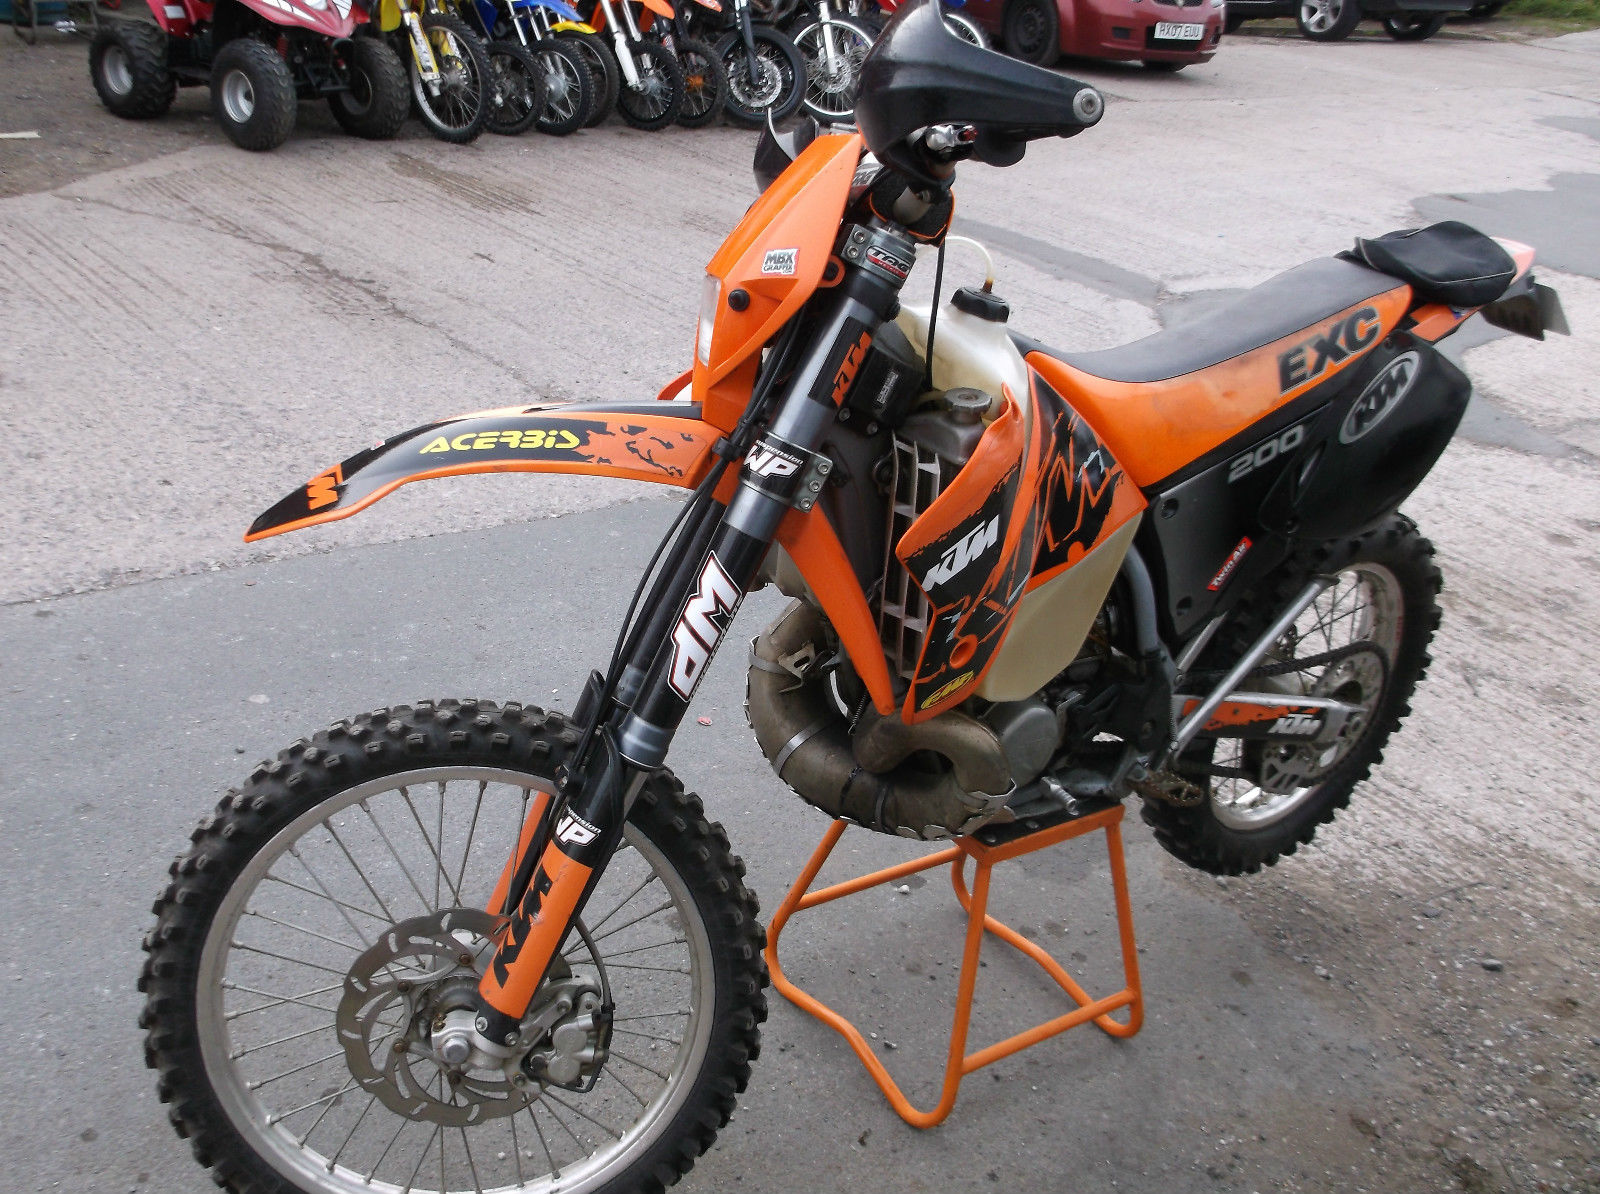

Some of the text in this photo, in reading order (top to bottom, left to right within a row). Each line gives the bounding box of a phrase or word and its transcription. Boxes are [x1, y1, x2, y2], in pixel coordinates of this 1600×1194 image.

[764, 252, 794, 264] MBX
[872, 247, 911, 273] TAG
[831, 331, 873, 407] KTM
[1277, 305, 1381, 396] EXC
[1350, 363, 1412, 436] KTM
[419, 430, 580, 454] ACERBIS
[743, 444, 800, 478] WP
[1227, 424, 1304, 484] 200
[922, 514, 1000, 592] KTM
[1268, 713, 1322, 735] KTM
[493, 865, 553, 988] KTM
